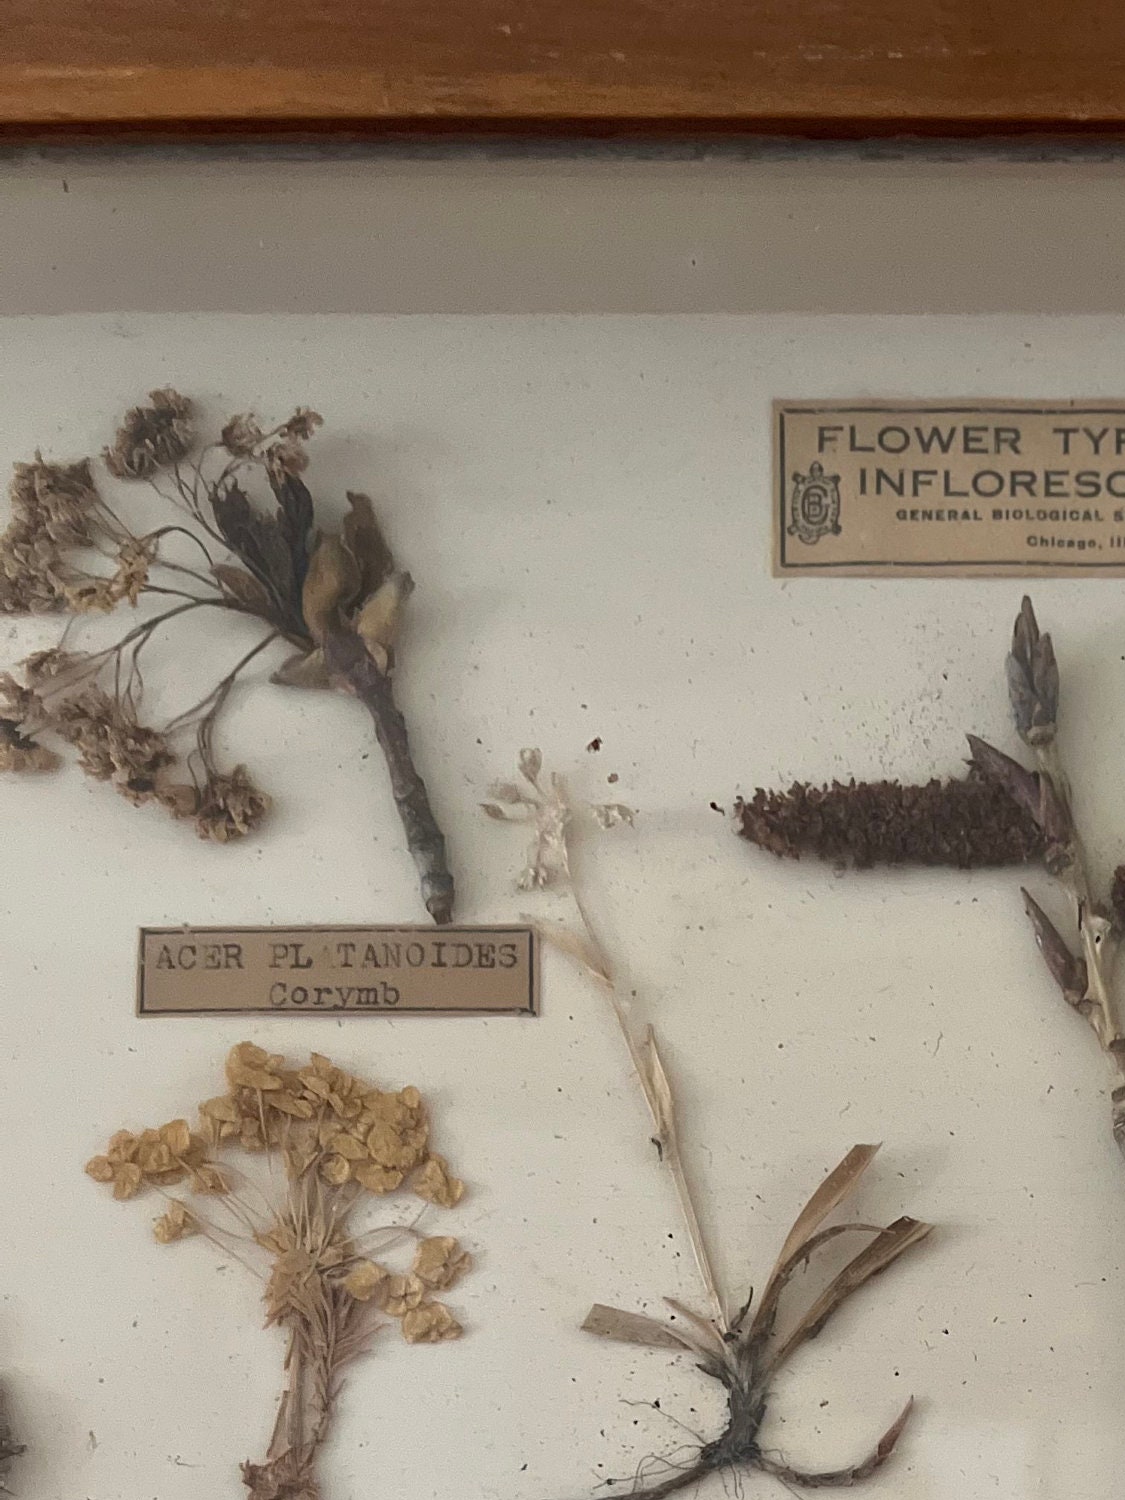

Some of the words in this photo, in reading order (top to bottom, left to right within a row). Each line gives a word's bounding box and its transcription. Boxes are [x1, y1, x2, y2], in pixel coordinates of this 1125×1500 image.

[817, 426, 1022, 455] FLOWER
[896, 509, 983, 522] GENERAL
[991, 509, 1105, 522] BIOLOGICAL
[1026, 535, 1103, 550] Chicago,
[155, 943, 245, 970] ACER
[268, 941, 520, 970] PLTANOIDES
[269, 981, 401, 1009] Corymb
